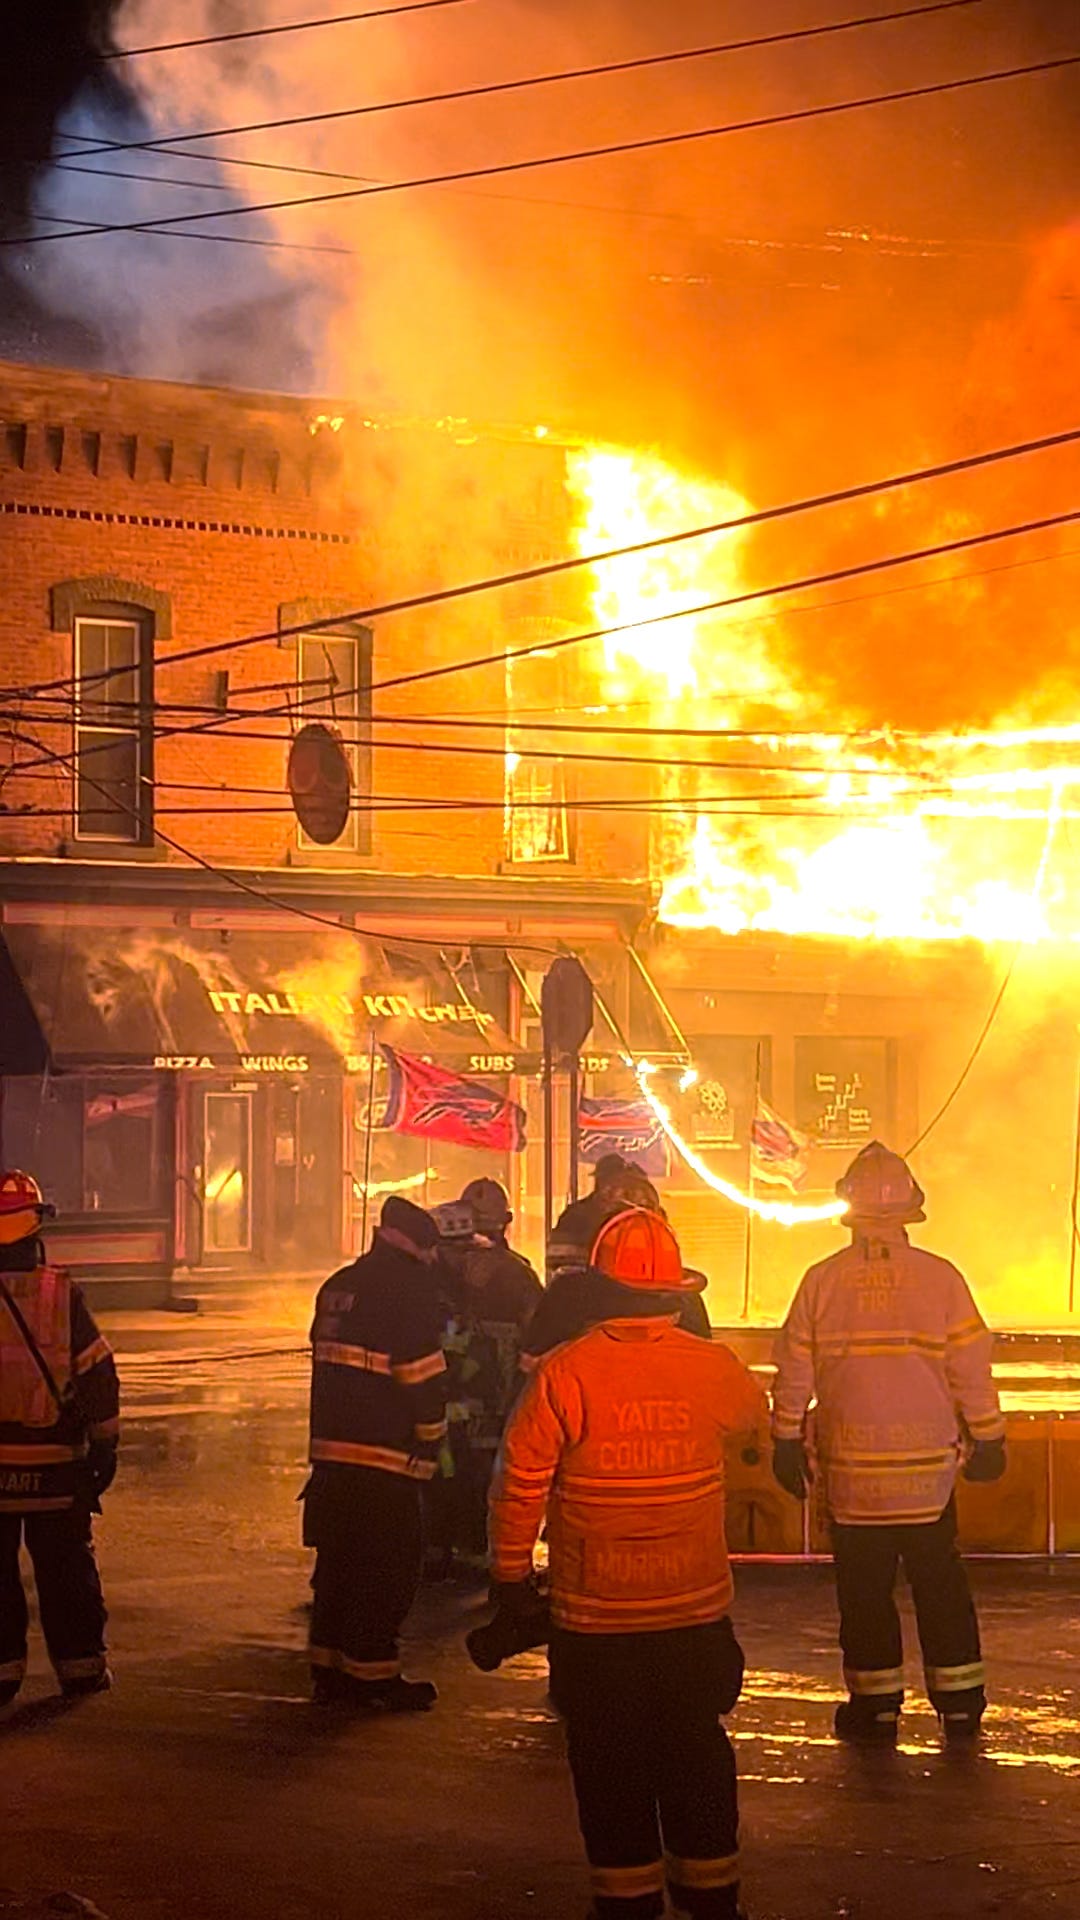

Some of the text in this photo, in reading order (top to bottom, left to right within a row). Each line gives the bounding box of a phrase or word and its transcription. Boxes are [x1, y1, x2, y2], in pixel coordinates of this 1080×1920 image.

[208, 991, 354, 1014] ITALIN
[154, 1056, 215, 1069] PIZZA
[241, 1056, 309, 1071] WINGS
[469, 1055, 515, 1071] SUBS
[857, 1289, 897, 1313] FIR
[612, 1400, 691, 1432] YATES
[599, 1439, 698, 1471] COUNTY
[597, 1547, 693, 1585] MURPHY
